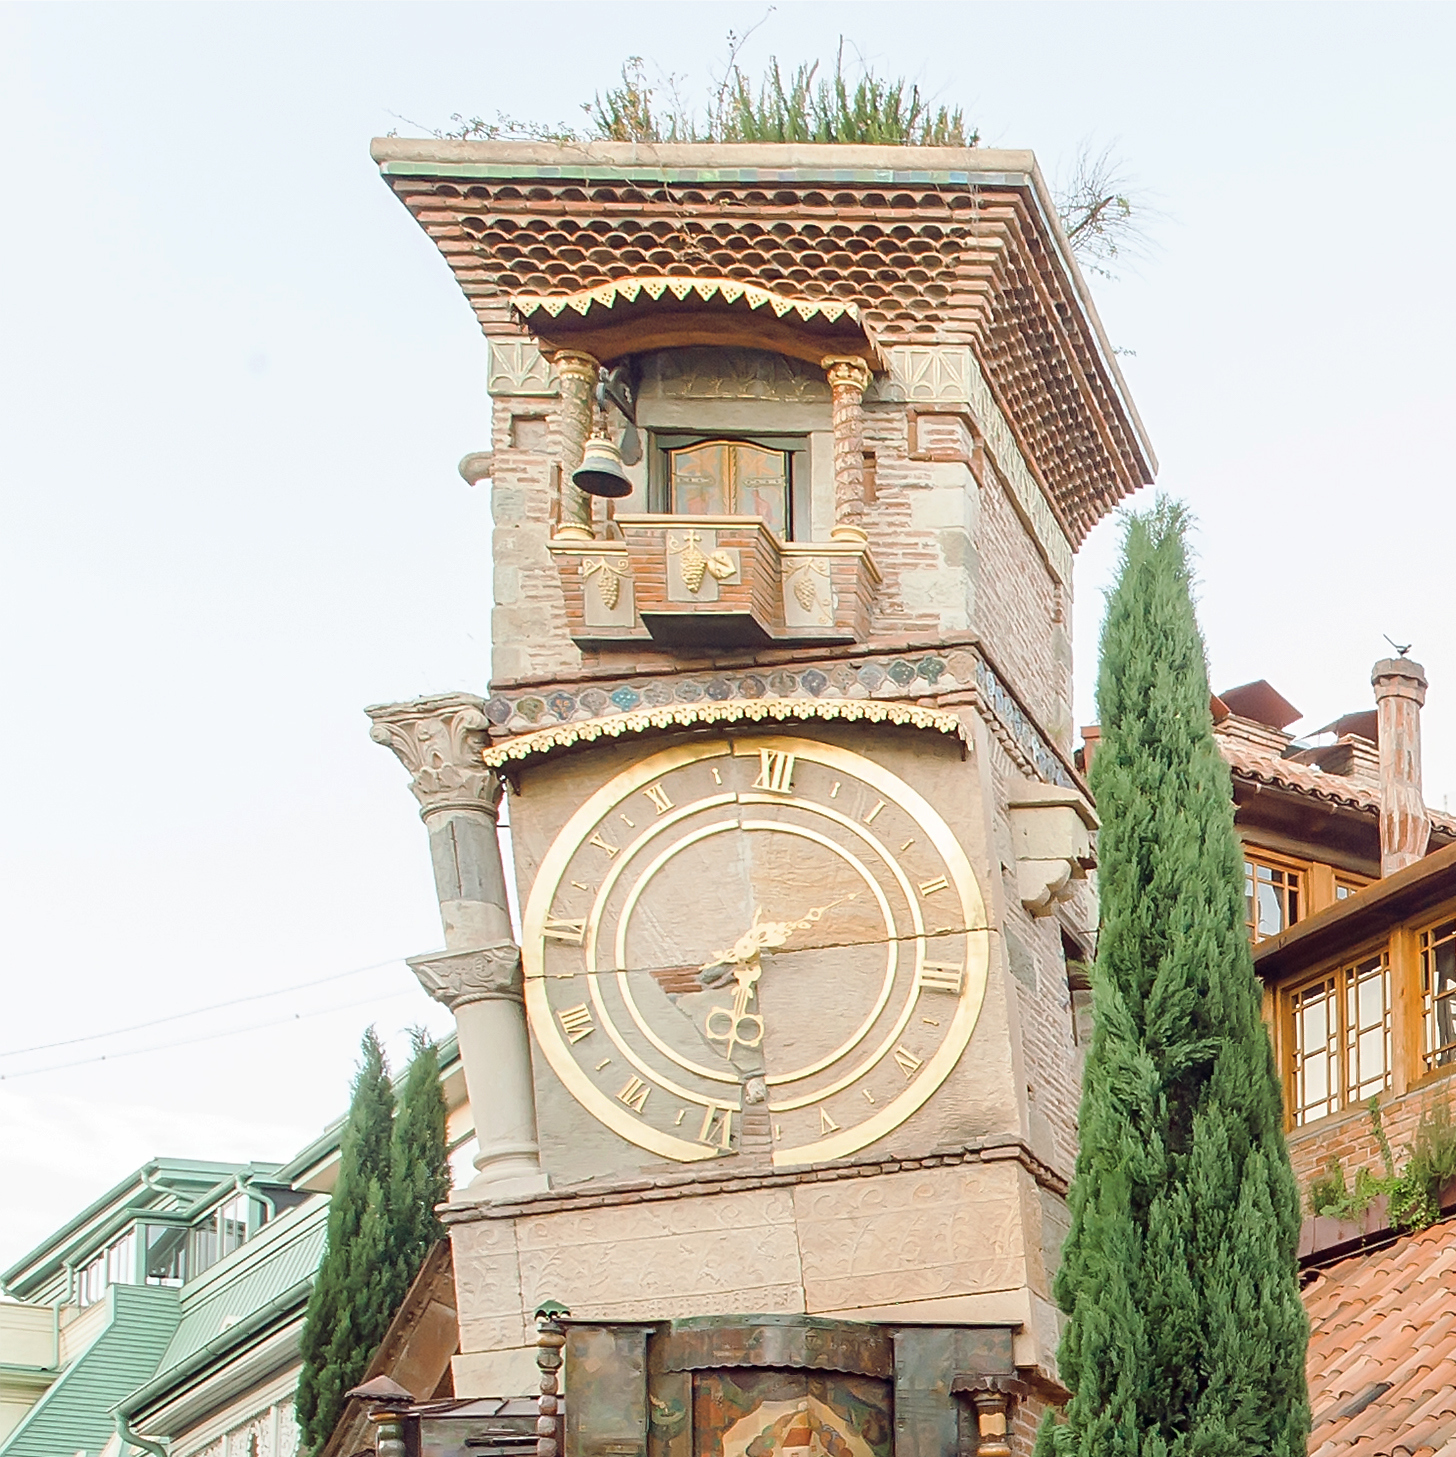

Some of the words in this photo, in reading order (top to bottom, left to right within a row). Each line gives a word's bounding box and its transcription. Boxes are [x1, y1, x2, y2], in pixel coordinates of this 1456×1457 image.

[752, 747, 794, 794] XII
[642, 784, 675, 816] XI
[589, 834, 621, 859] X
[918, 874, 949, 897] II
[541, 912, 588, 948] IX
[920, 958, 963, 994] III
[557, 1002, 595, 1045] VIII
[894, 1044, 924, 1079] IV
[615, 1074, 652, 1116] VII
[698, 1102, 737, 1152] VI
[818, 1108, 840, 1136] V
